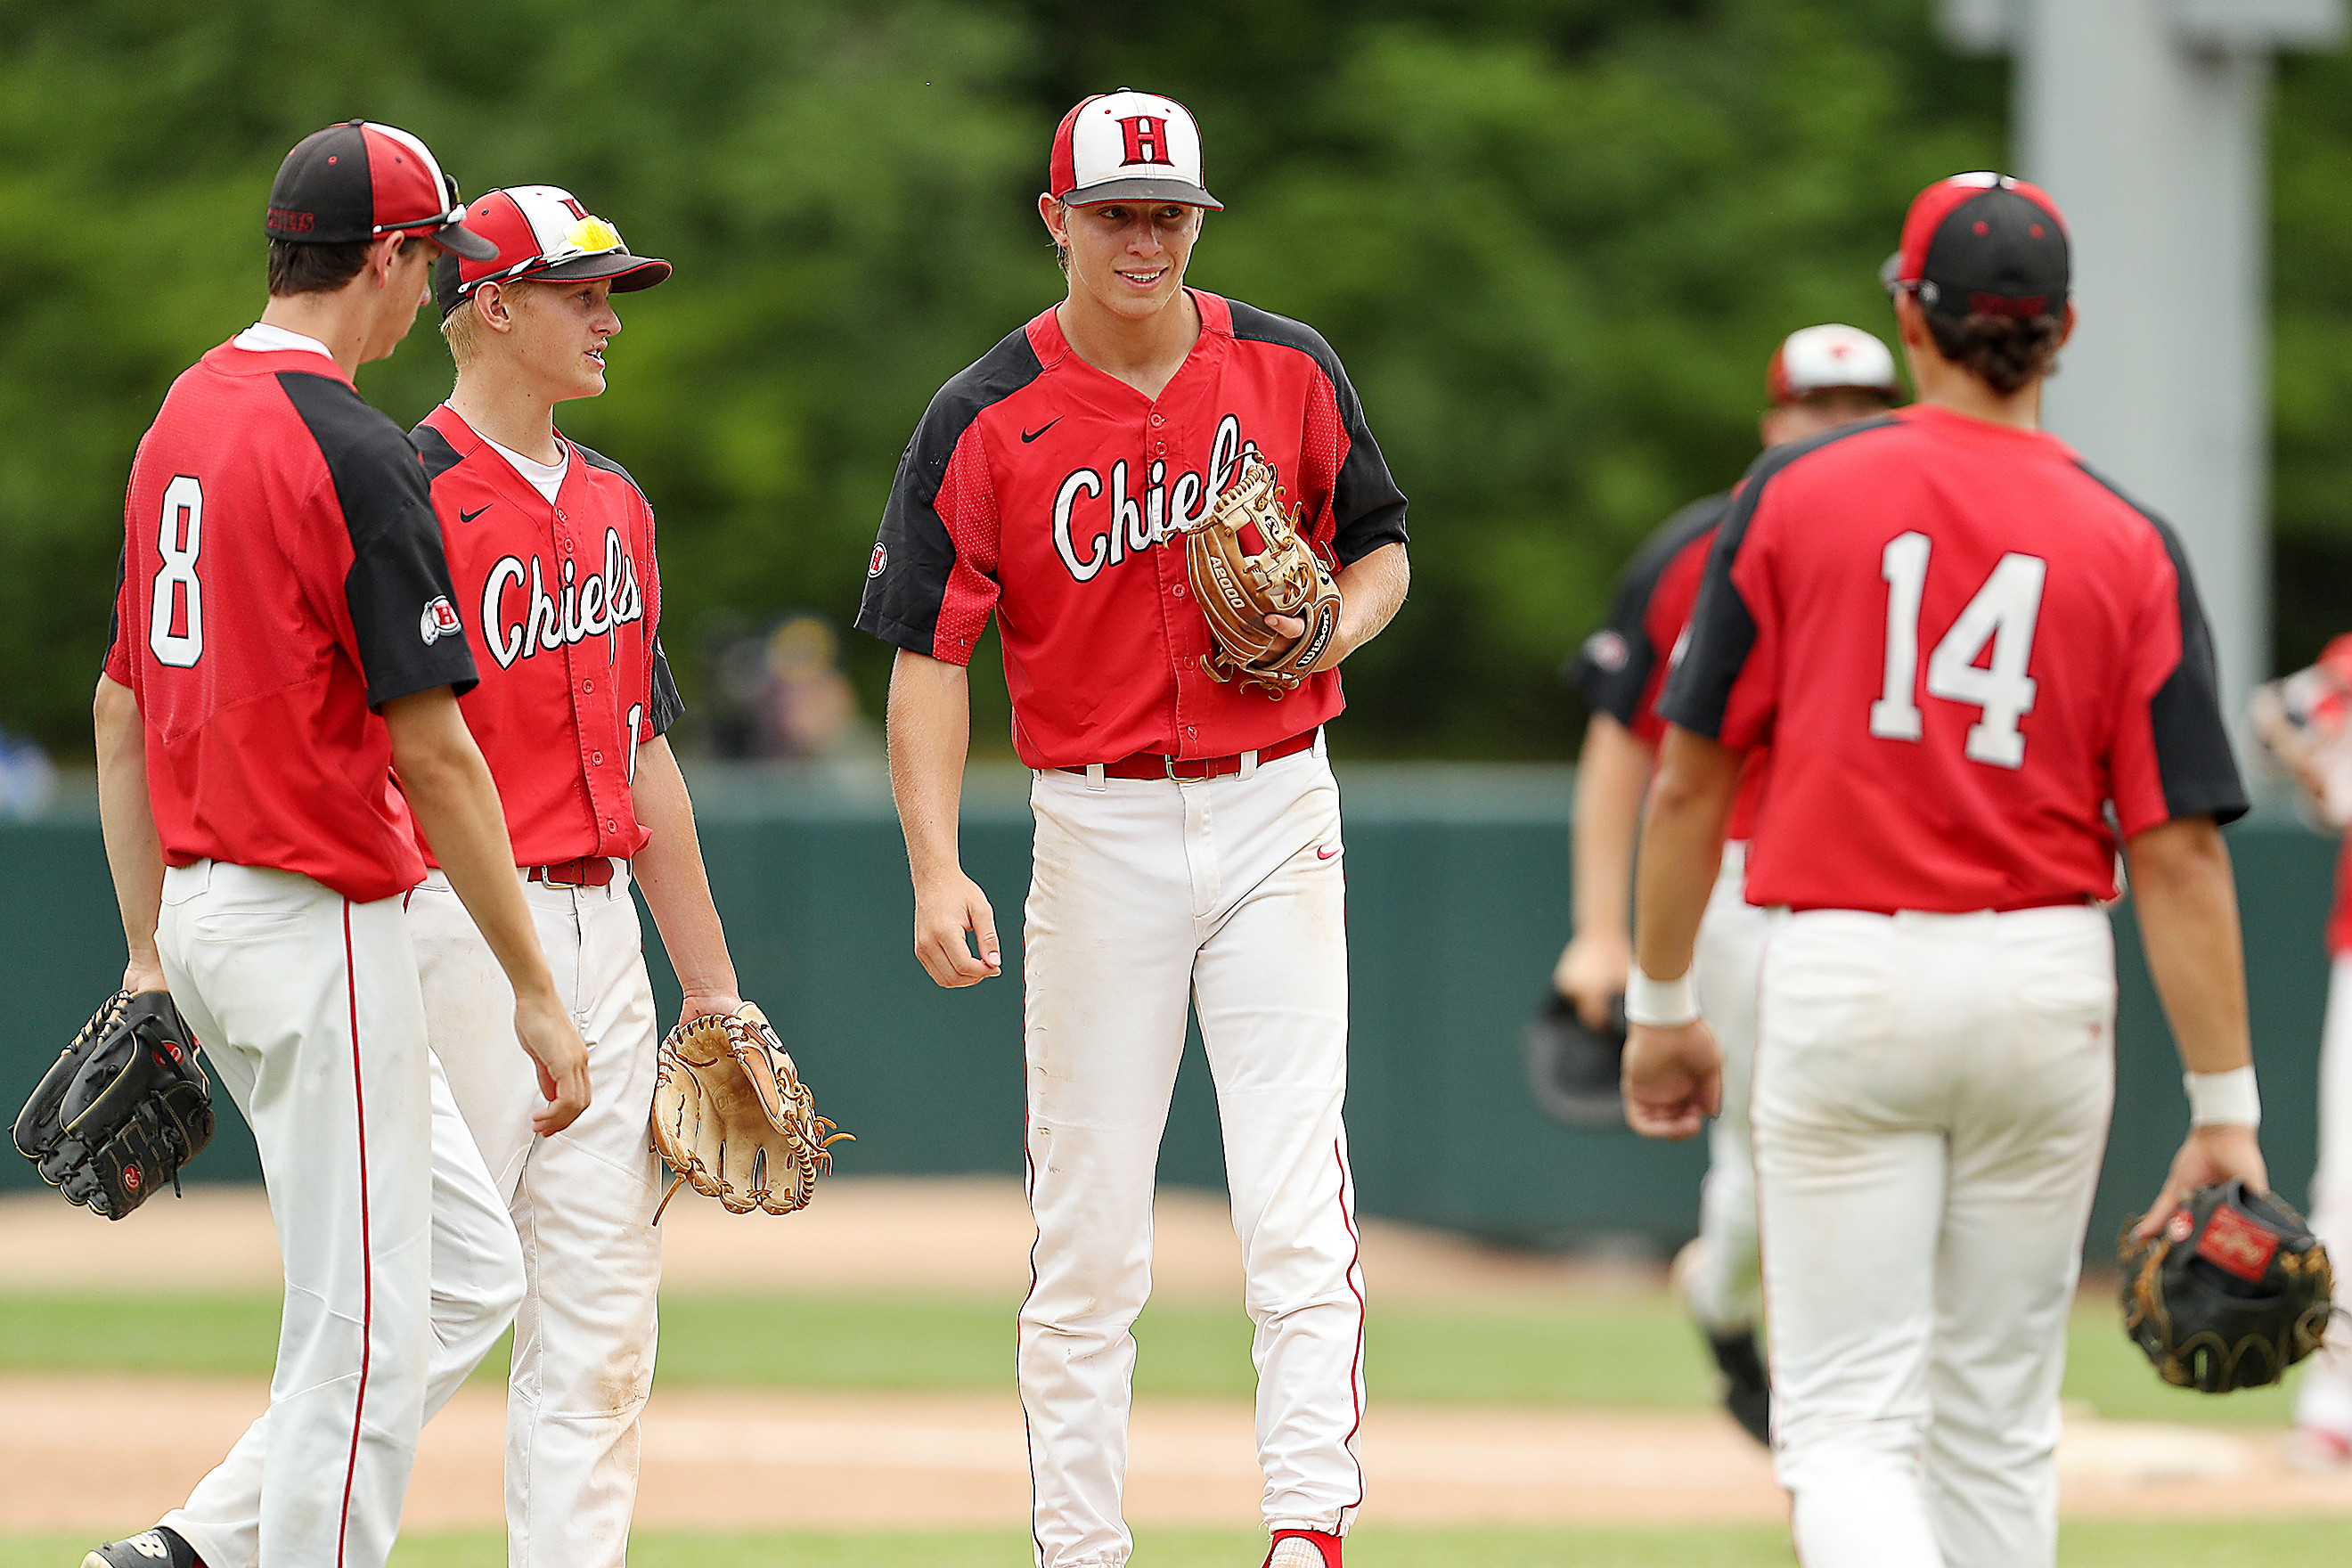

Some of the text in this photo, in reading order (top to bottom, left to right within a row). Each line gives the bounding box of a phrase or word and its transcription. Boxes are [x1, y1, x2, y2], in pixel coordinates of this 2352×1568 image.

[1115, 116, 1175, 167] H
[149, 475, 203, 668] 8
[481, 527, 642, 671] Chiefs
[1210, 556, 1245, 609] A2000
[433, 603, 456, 626] H
[1297, 610, 1331, 666] Wilson
[1869, 529, 2048, 772] 14
